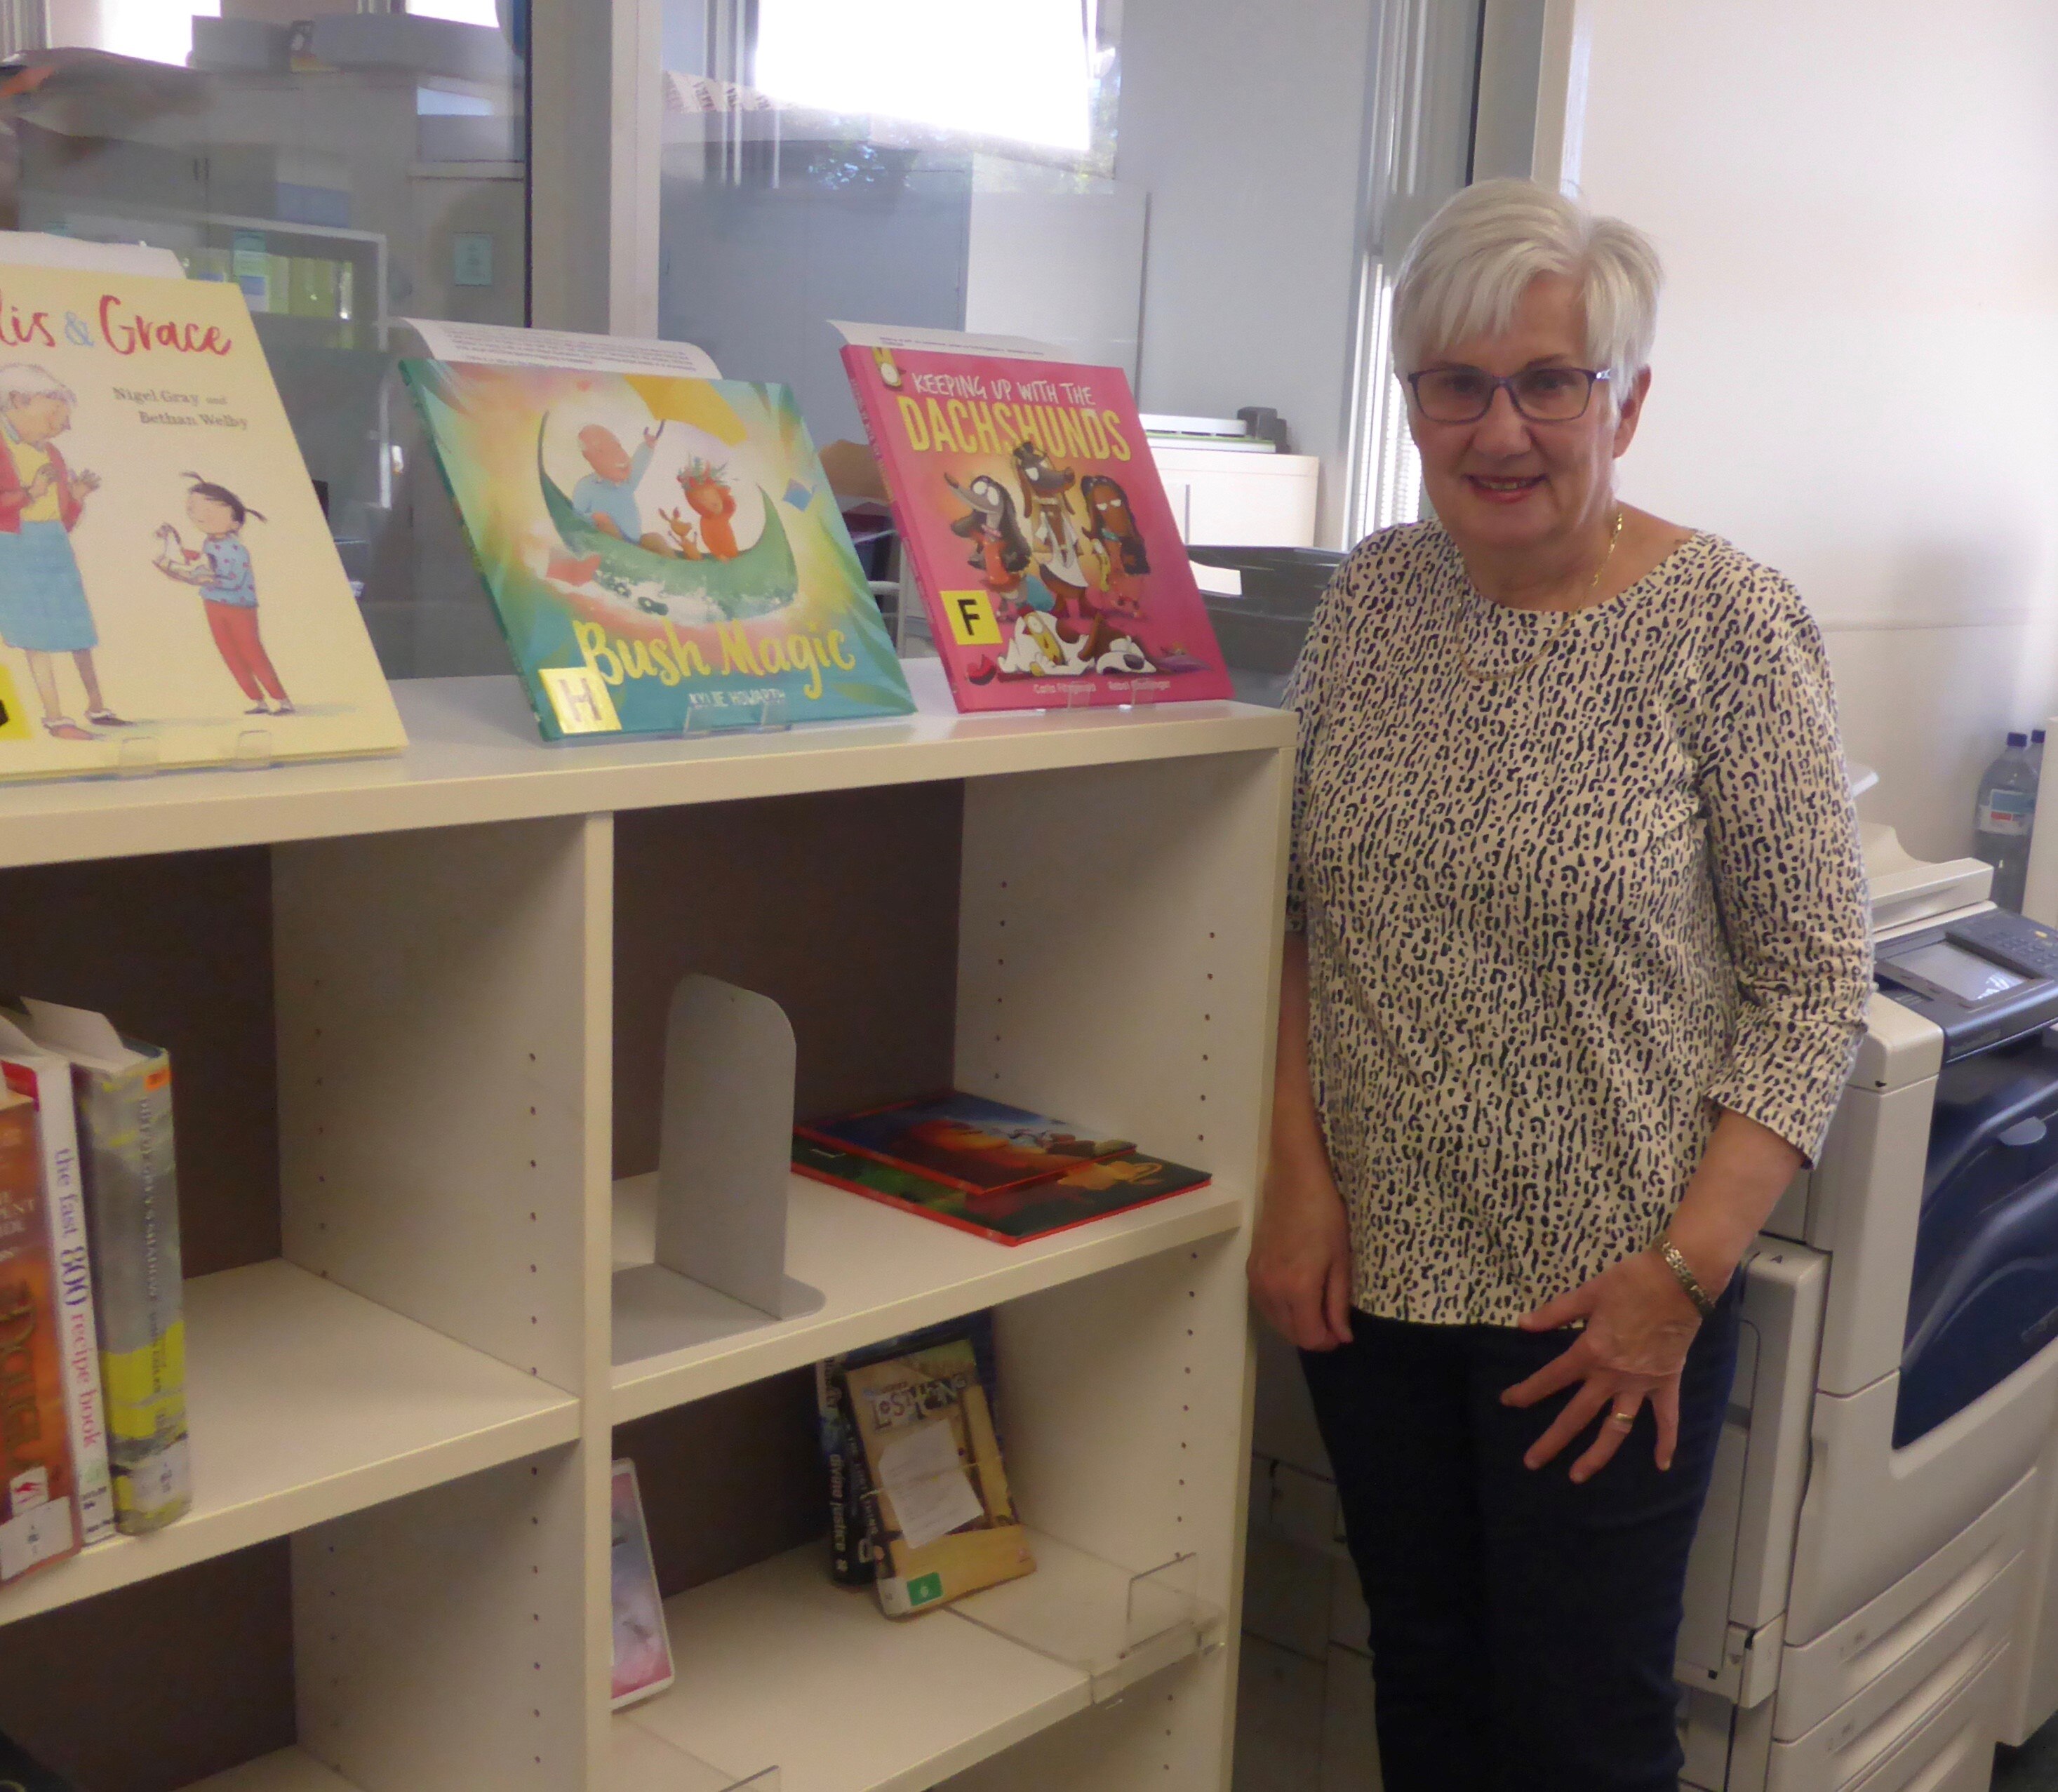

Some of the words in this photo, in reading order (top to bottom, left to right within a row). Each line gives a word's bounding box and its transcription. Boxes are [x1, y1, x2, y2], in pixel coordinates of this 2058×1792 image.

[65, 311, 95, 346] &
[99, 295, 232, 356] Grace
[112, 387, 158, 405] Nigel
[160, 389, 199, 407] Gray
[911, 373, 986, 399] KEEPING
[990, 379, 1012, 401] UP
[1016, 380, 1058, 405] WITH
[1060, 382, 1096, 406] THE
[138, 410, 199, 426] Bethan
[895, 395, 1132, 461] DACHSHUNDS
[957, 599, 980, 636] F
[572, 616, 711, 686] Bush
[717, 618, 855, 700] Magic
[557, 677, 602, 723] H
[55, 1148, 73, 1186] the
[59, 1193, 79, 1238] fast
[60, 1246, 88, 1306] 800
[71, 1313, 93, 1384] recipe
[80, 1389, 102, 1450] book
